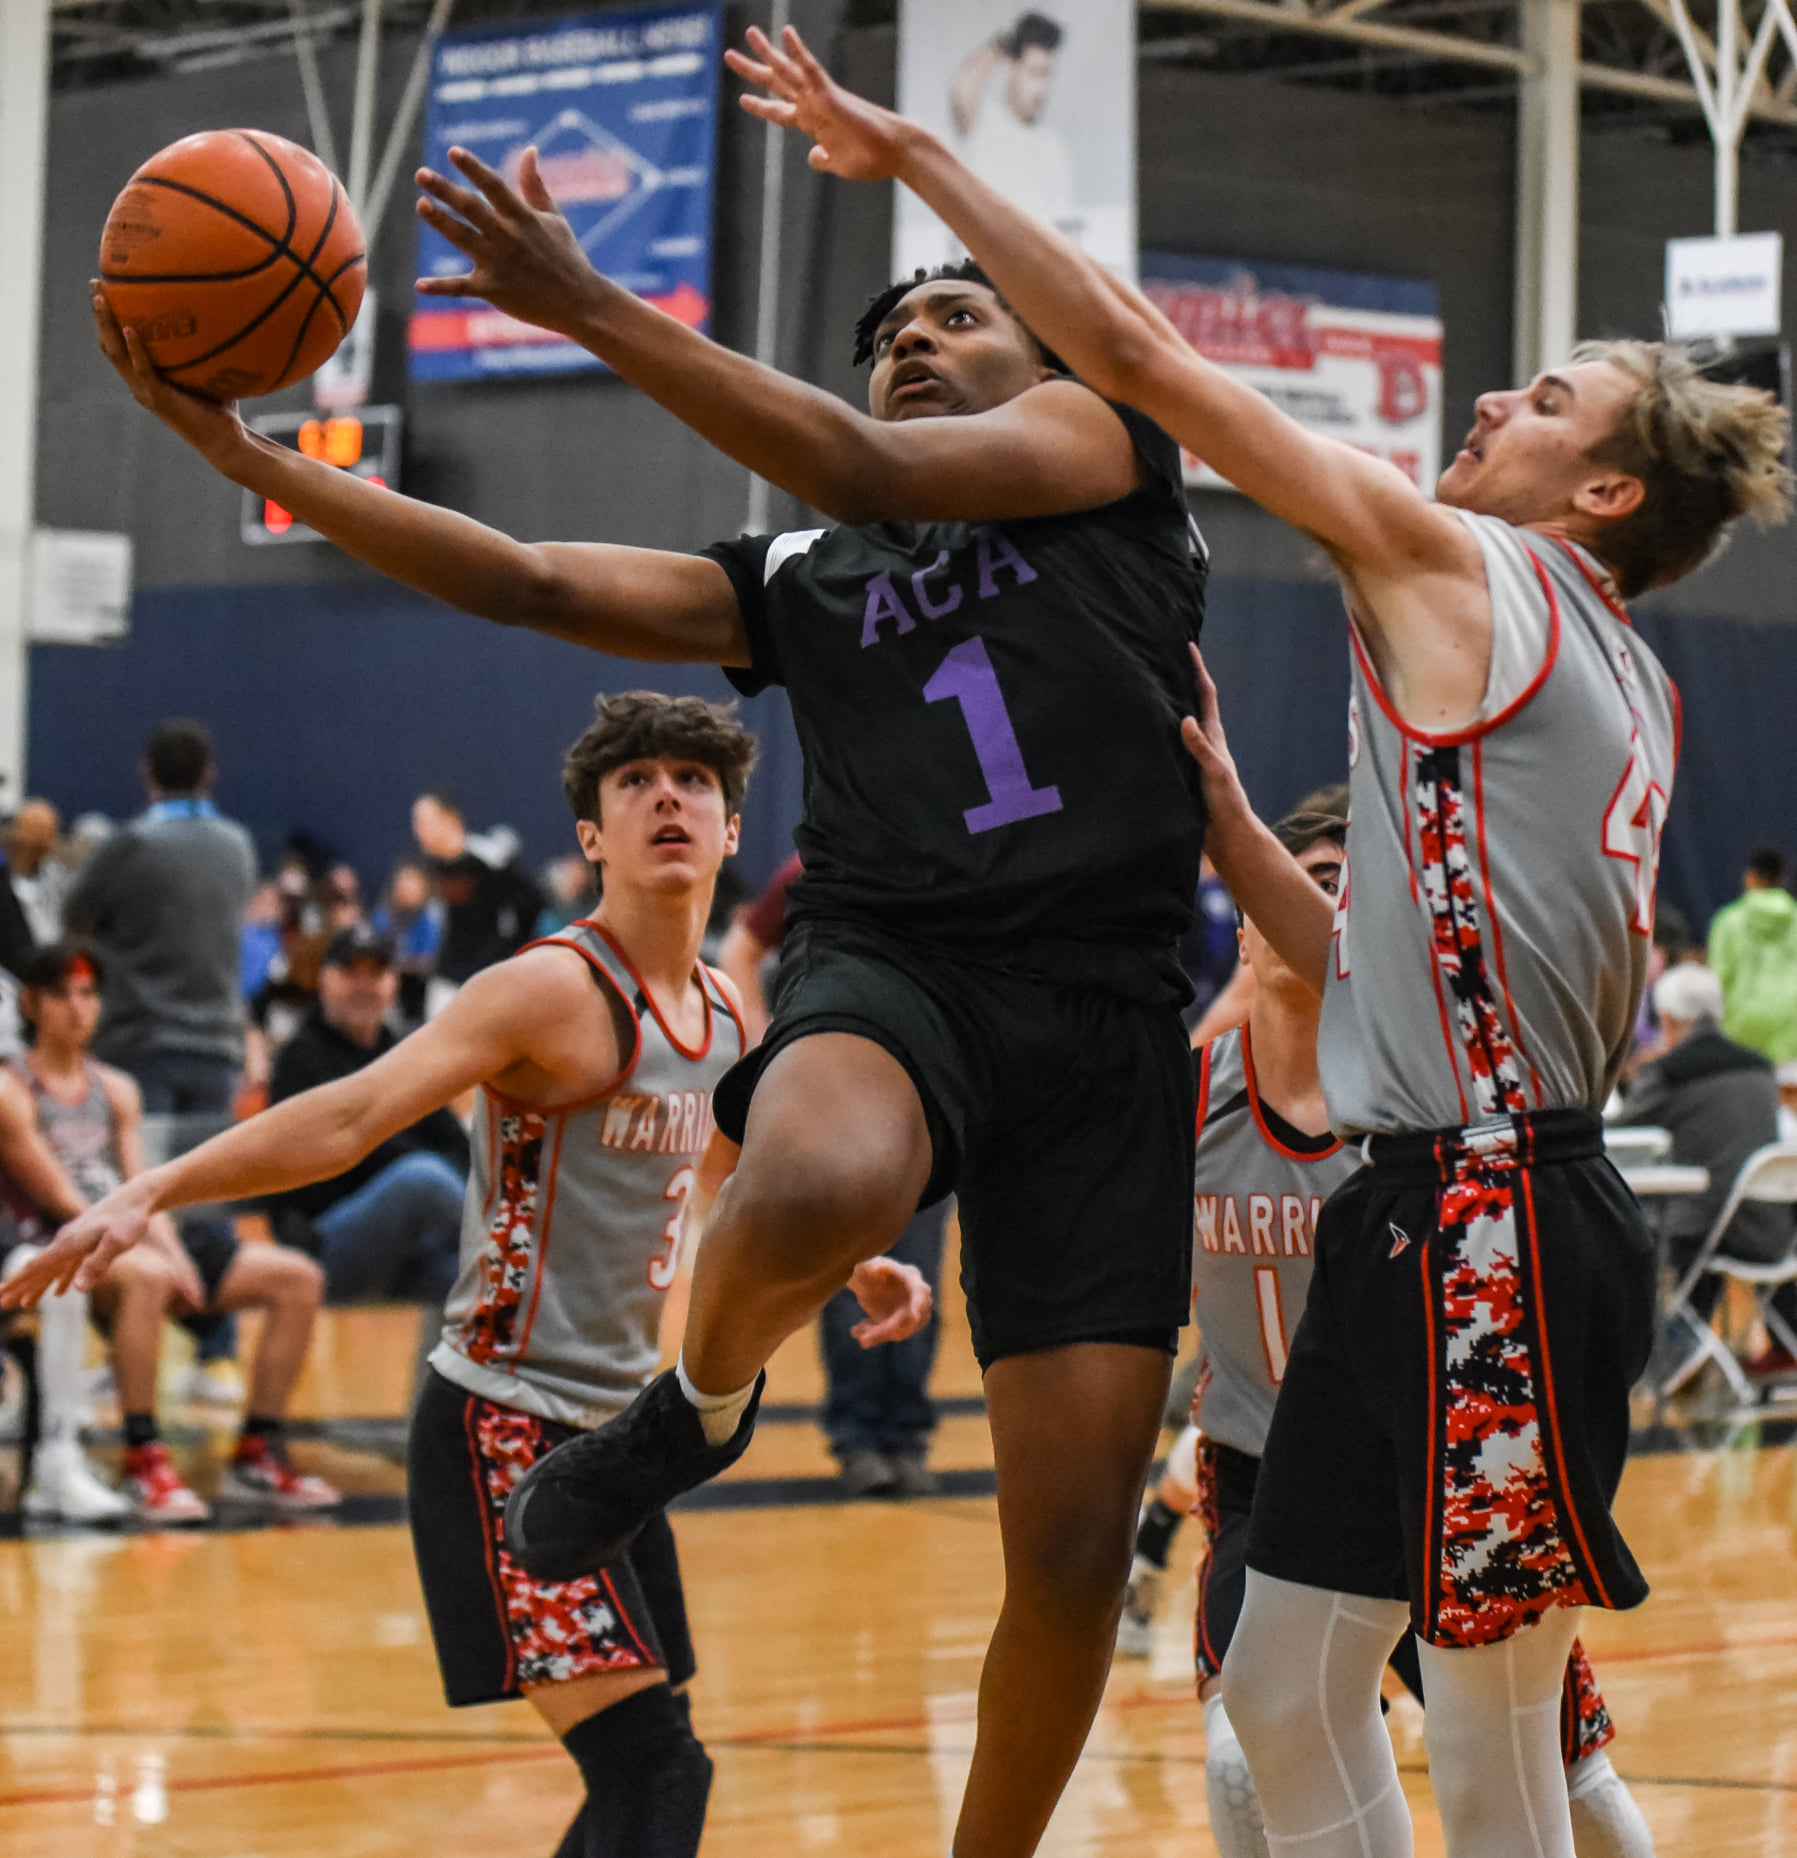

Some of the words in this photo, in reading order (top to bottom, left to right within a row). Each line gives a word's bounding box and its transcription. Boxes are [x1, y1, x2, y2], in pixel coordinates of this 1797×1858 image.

[861, 526, 1038, 648] ACA
[922, 634, 1064, 835] 1
[648, 1163, 695, 1291] 3
[1253, 1264, 1292, 1386] 1
